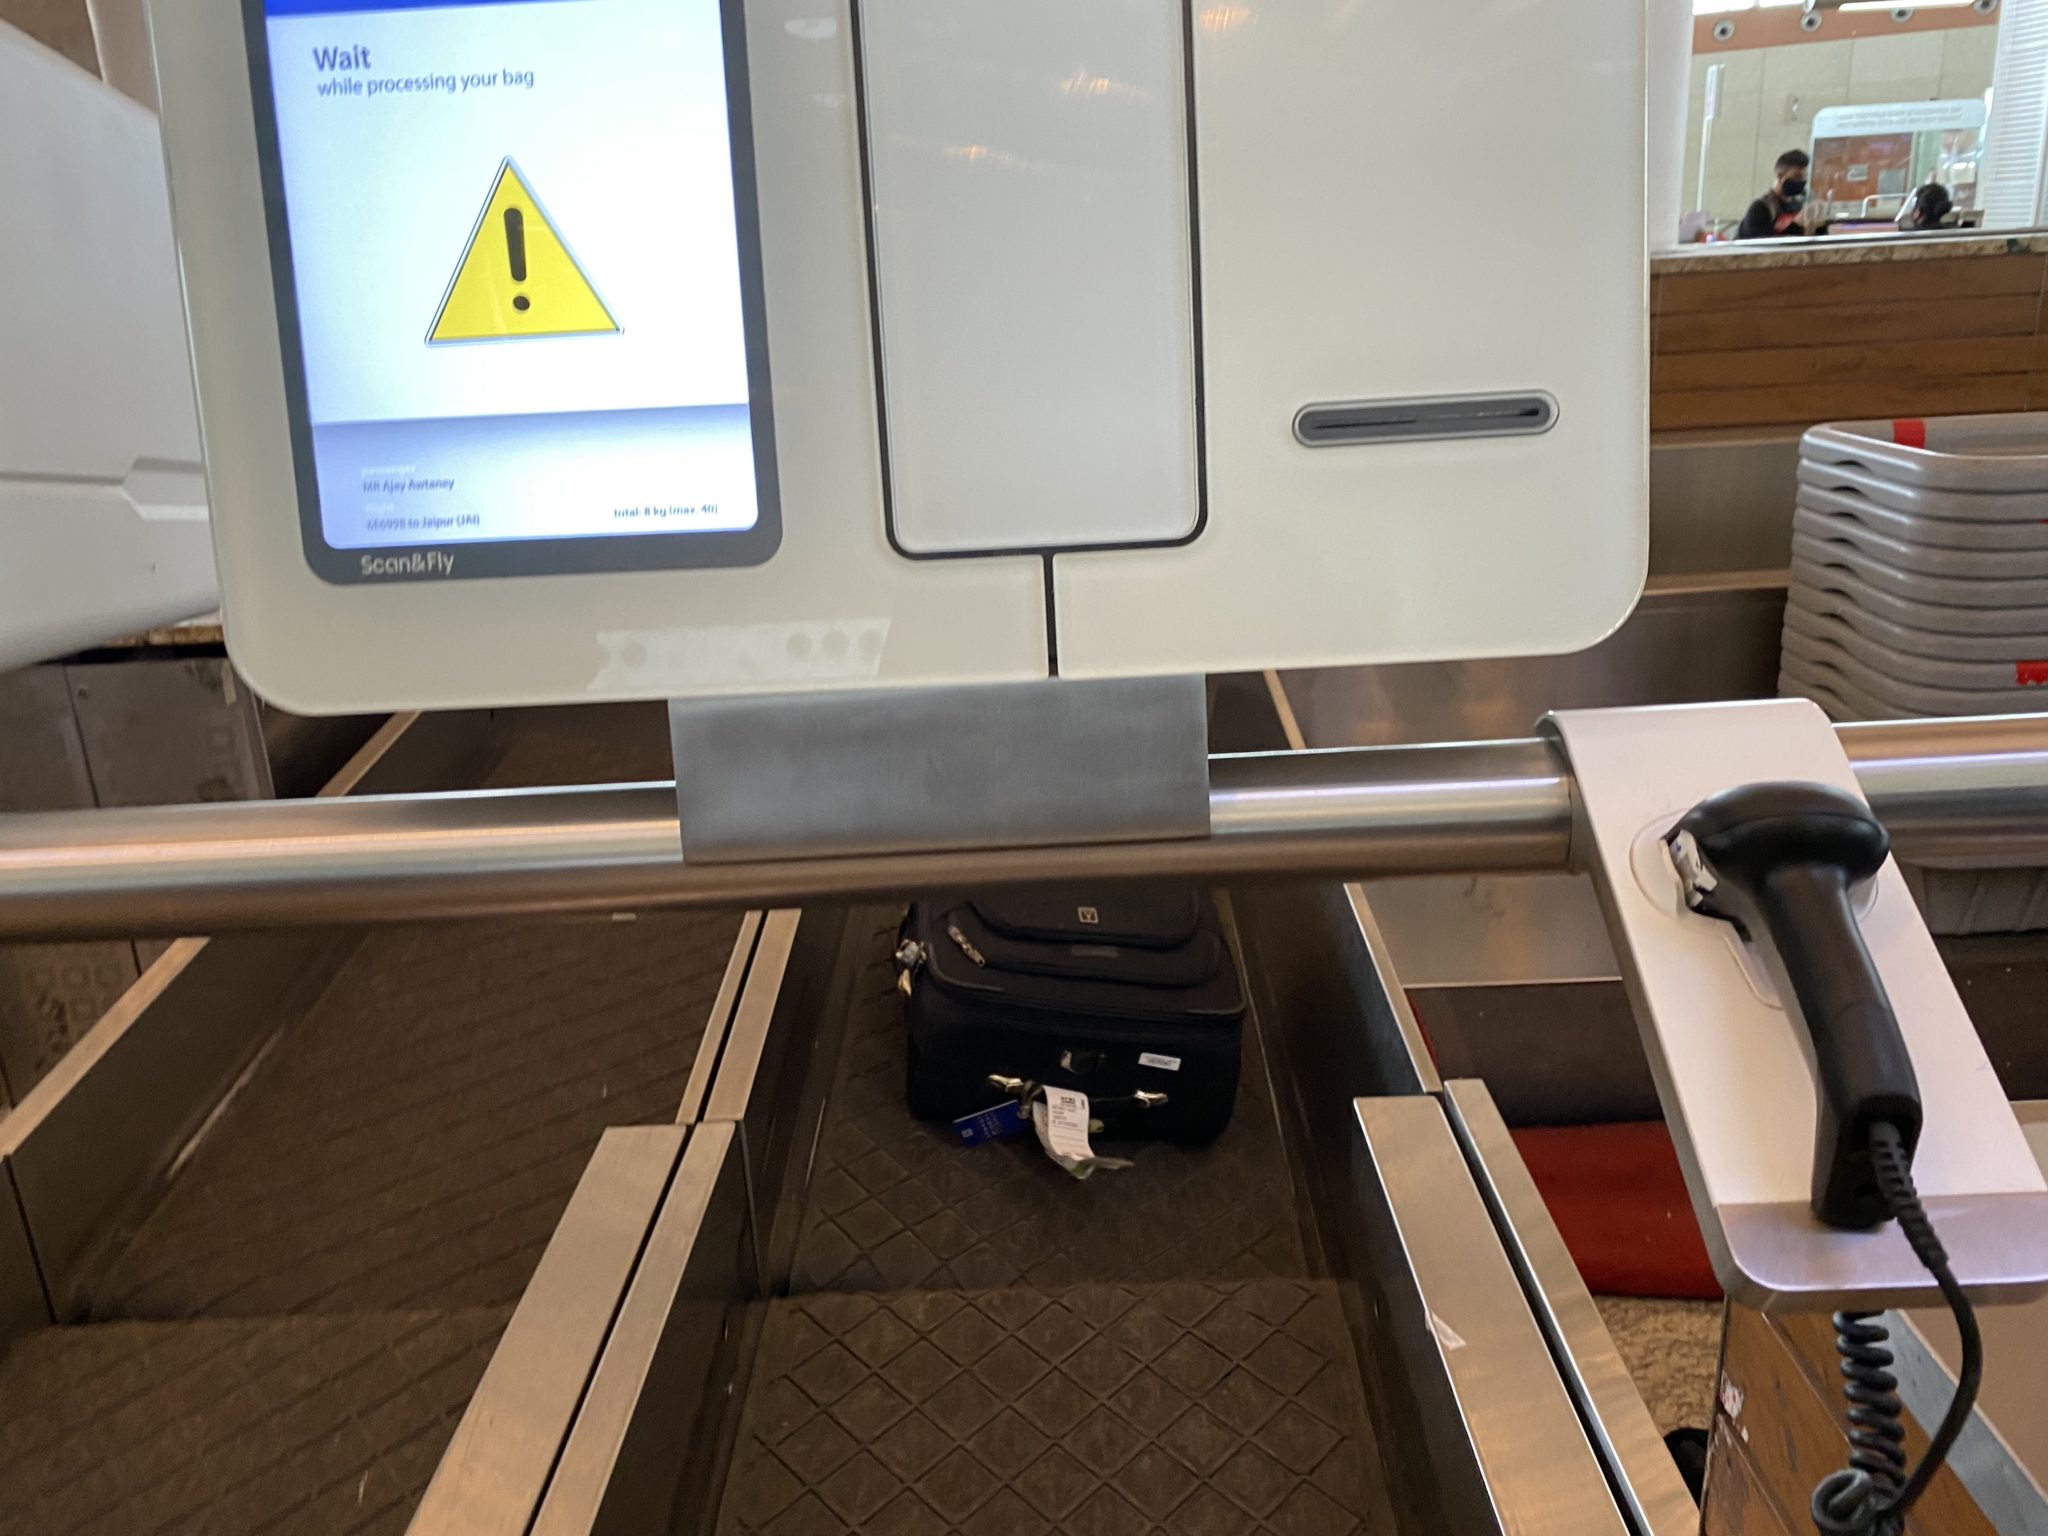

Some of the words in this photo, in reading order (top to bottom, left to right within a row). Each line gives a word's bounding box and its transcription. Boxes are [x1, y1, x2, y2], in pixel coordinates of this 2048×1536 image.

[312, 44, 372, 72] Wait
[317, 77, 363, 97] while
[366, 73, 457, 98] processing
[459, 71, 499, 93] your
[502, 67, 535, 89] bag
[382, 479, 406, 495] Ajay
[653, 505, 667, 518] kg
[408, 518, 420, 530] to
[422, 516, 454, 531] Jaipur
[361, 550, 455, 577] Scan&Fly
